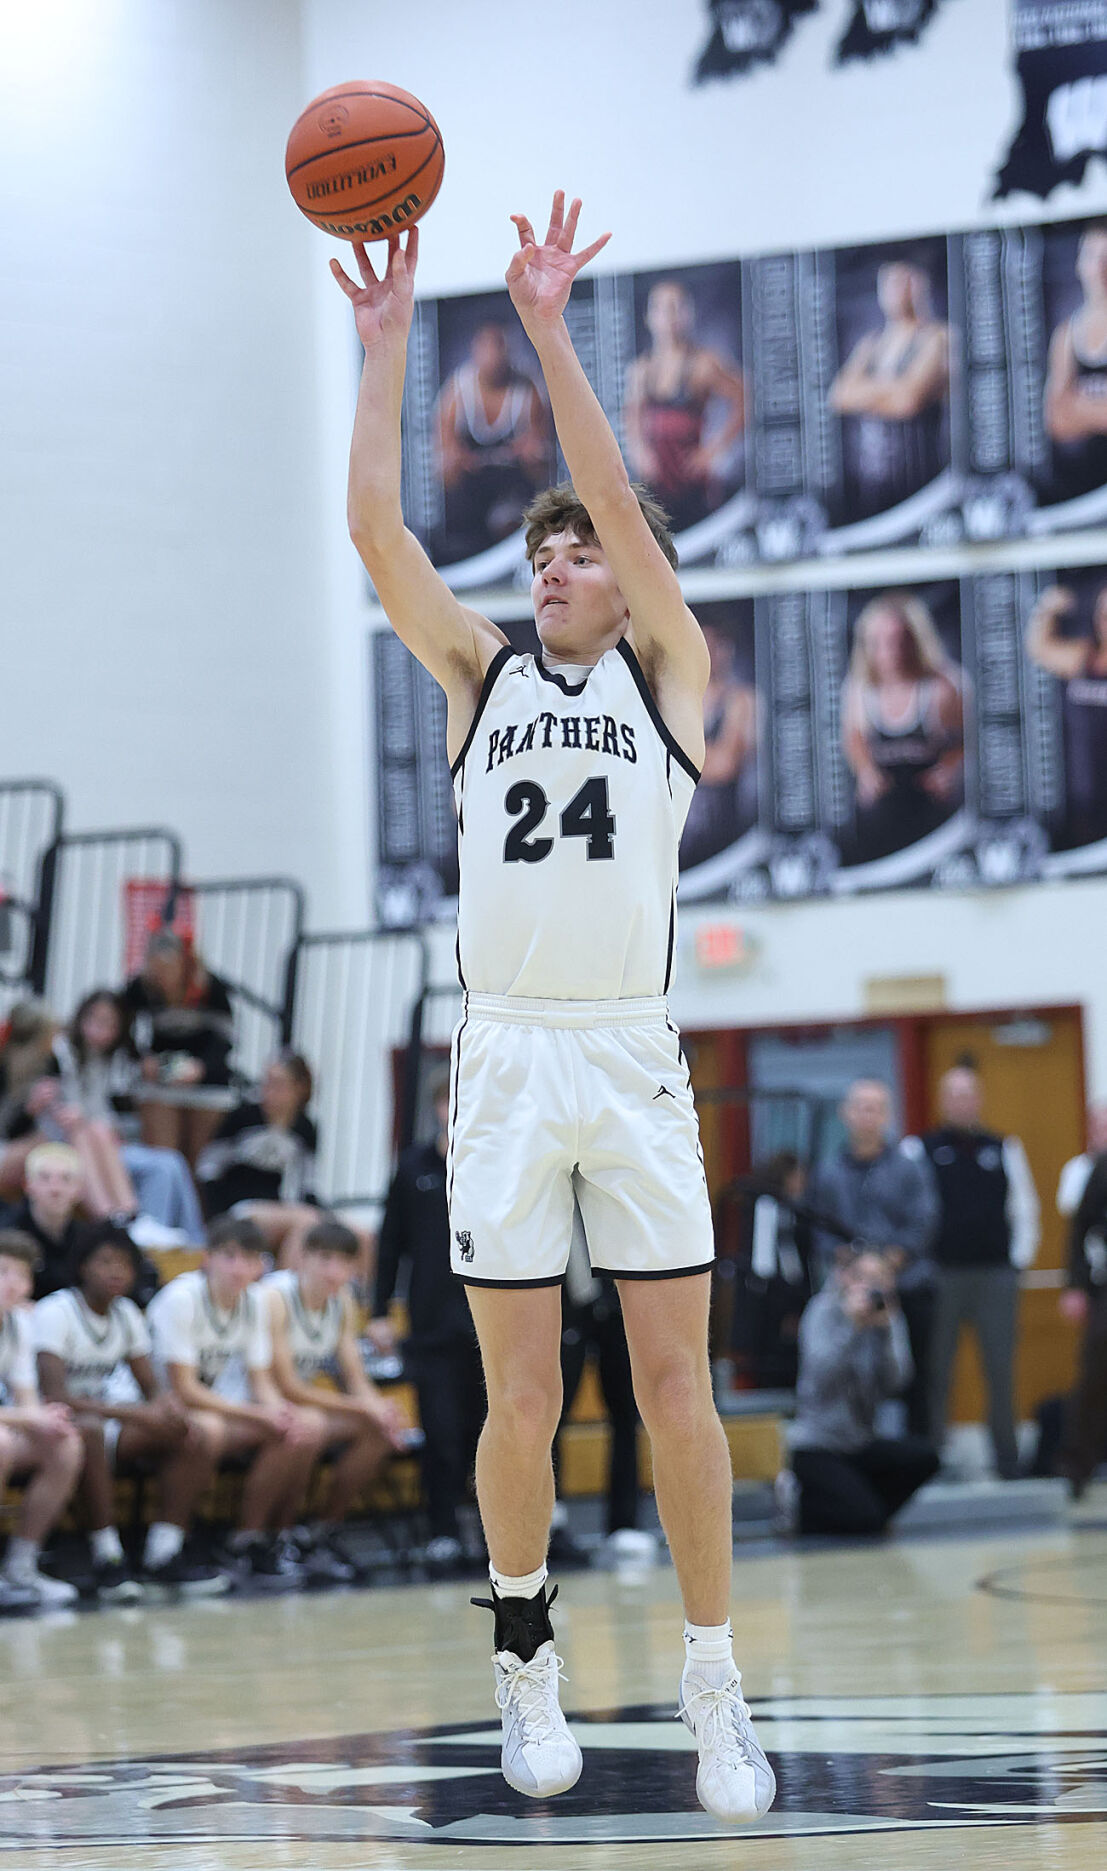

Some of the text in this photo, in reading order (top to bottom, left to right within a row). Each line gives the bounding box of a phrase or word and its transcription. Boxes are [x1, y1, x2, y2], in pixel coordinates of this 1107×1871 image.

[307, 154, 398, 201] EVOLUTION
[320, 194, 423, 235] Wilson
[486, 712, 638, 774] PANTHERS
[503, 775, 617, 864] 24
